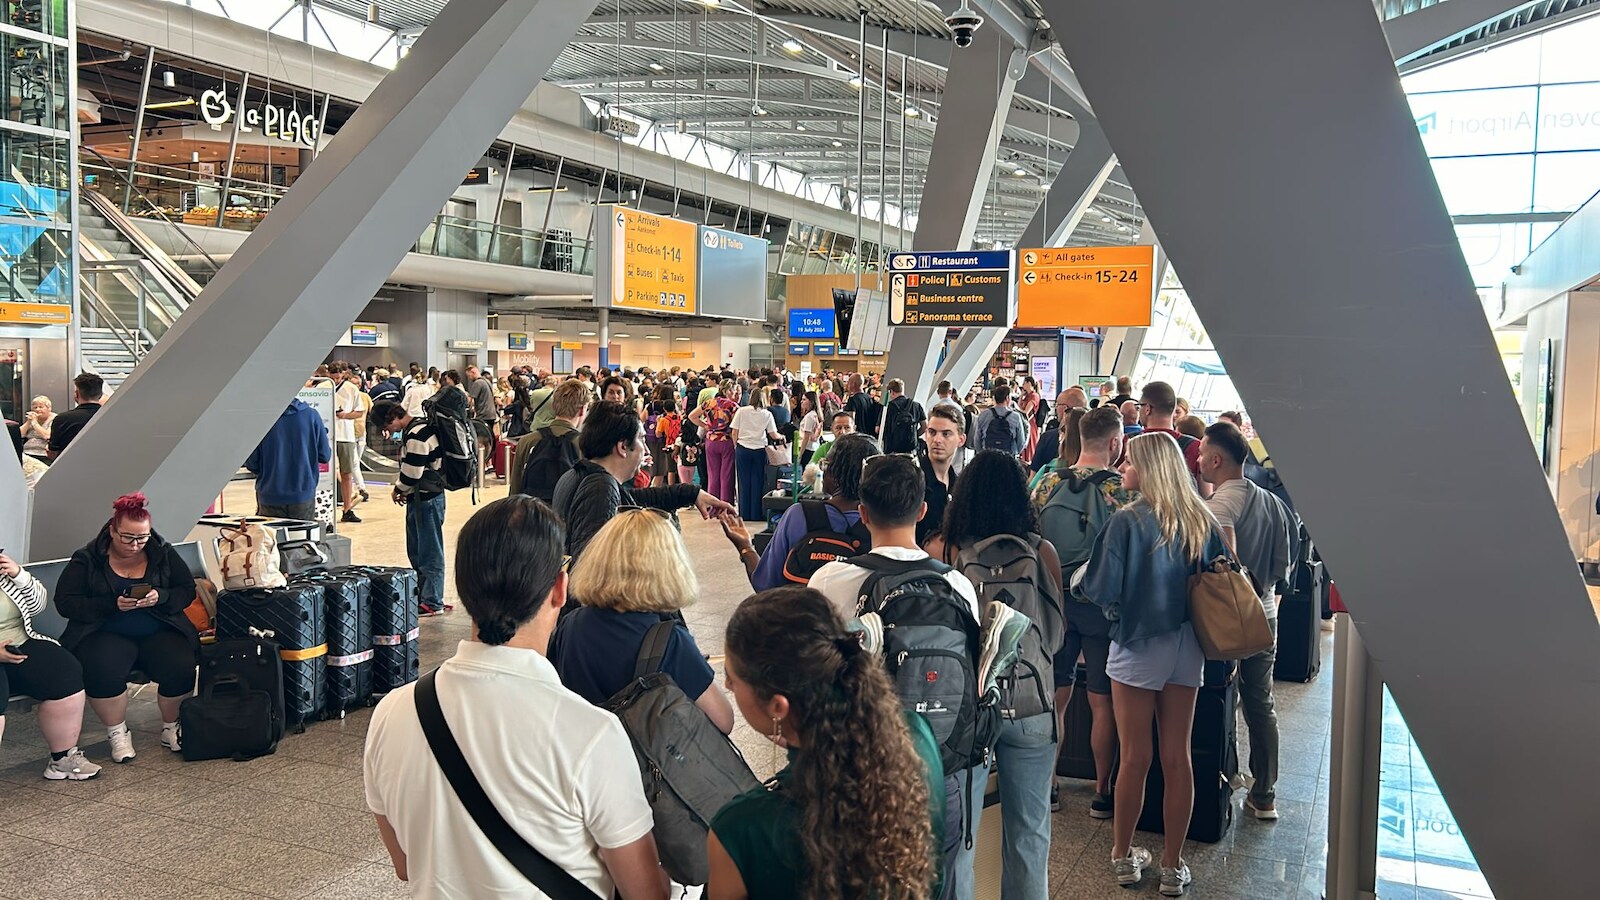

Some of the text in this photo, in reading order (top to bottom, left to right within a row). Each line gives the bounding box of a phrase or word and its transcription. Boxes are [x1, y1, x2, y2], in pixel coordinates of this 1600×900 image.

[220, 162, 265, 176] SOOTHIES
[637, 214, 660, 228] Arrivals
[636, 243, 682, 263] Check-in 1-14
[1056, 253, 1095, 263] All gates
[932, 256, 978, 266] Restaurant
[636, 266, 653, 278] Buses
[670, 272, 685, 283] Taxis
[1055, 270, 1138, 283] Check-in 15-24
[920, 275, 945, 285] Police
[964, 274, 1001, 284] Customs
[636, 291, 659, 305] Parking
[920, 294, 984, 303] Business centre
[919, 313, 993, 321] Panorama terrace
[512, 353, 540, 367] Mobility
